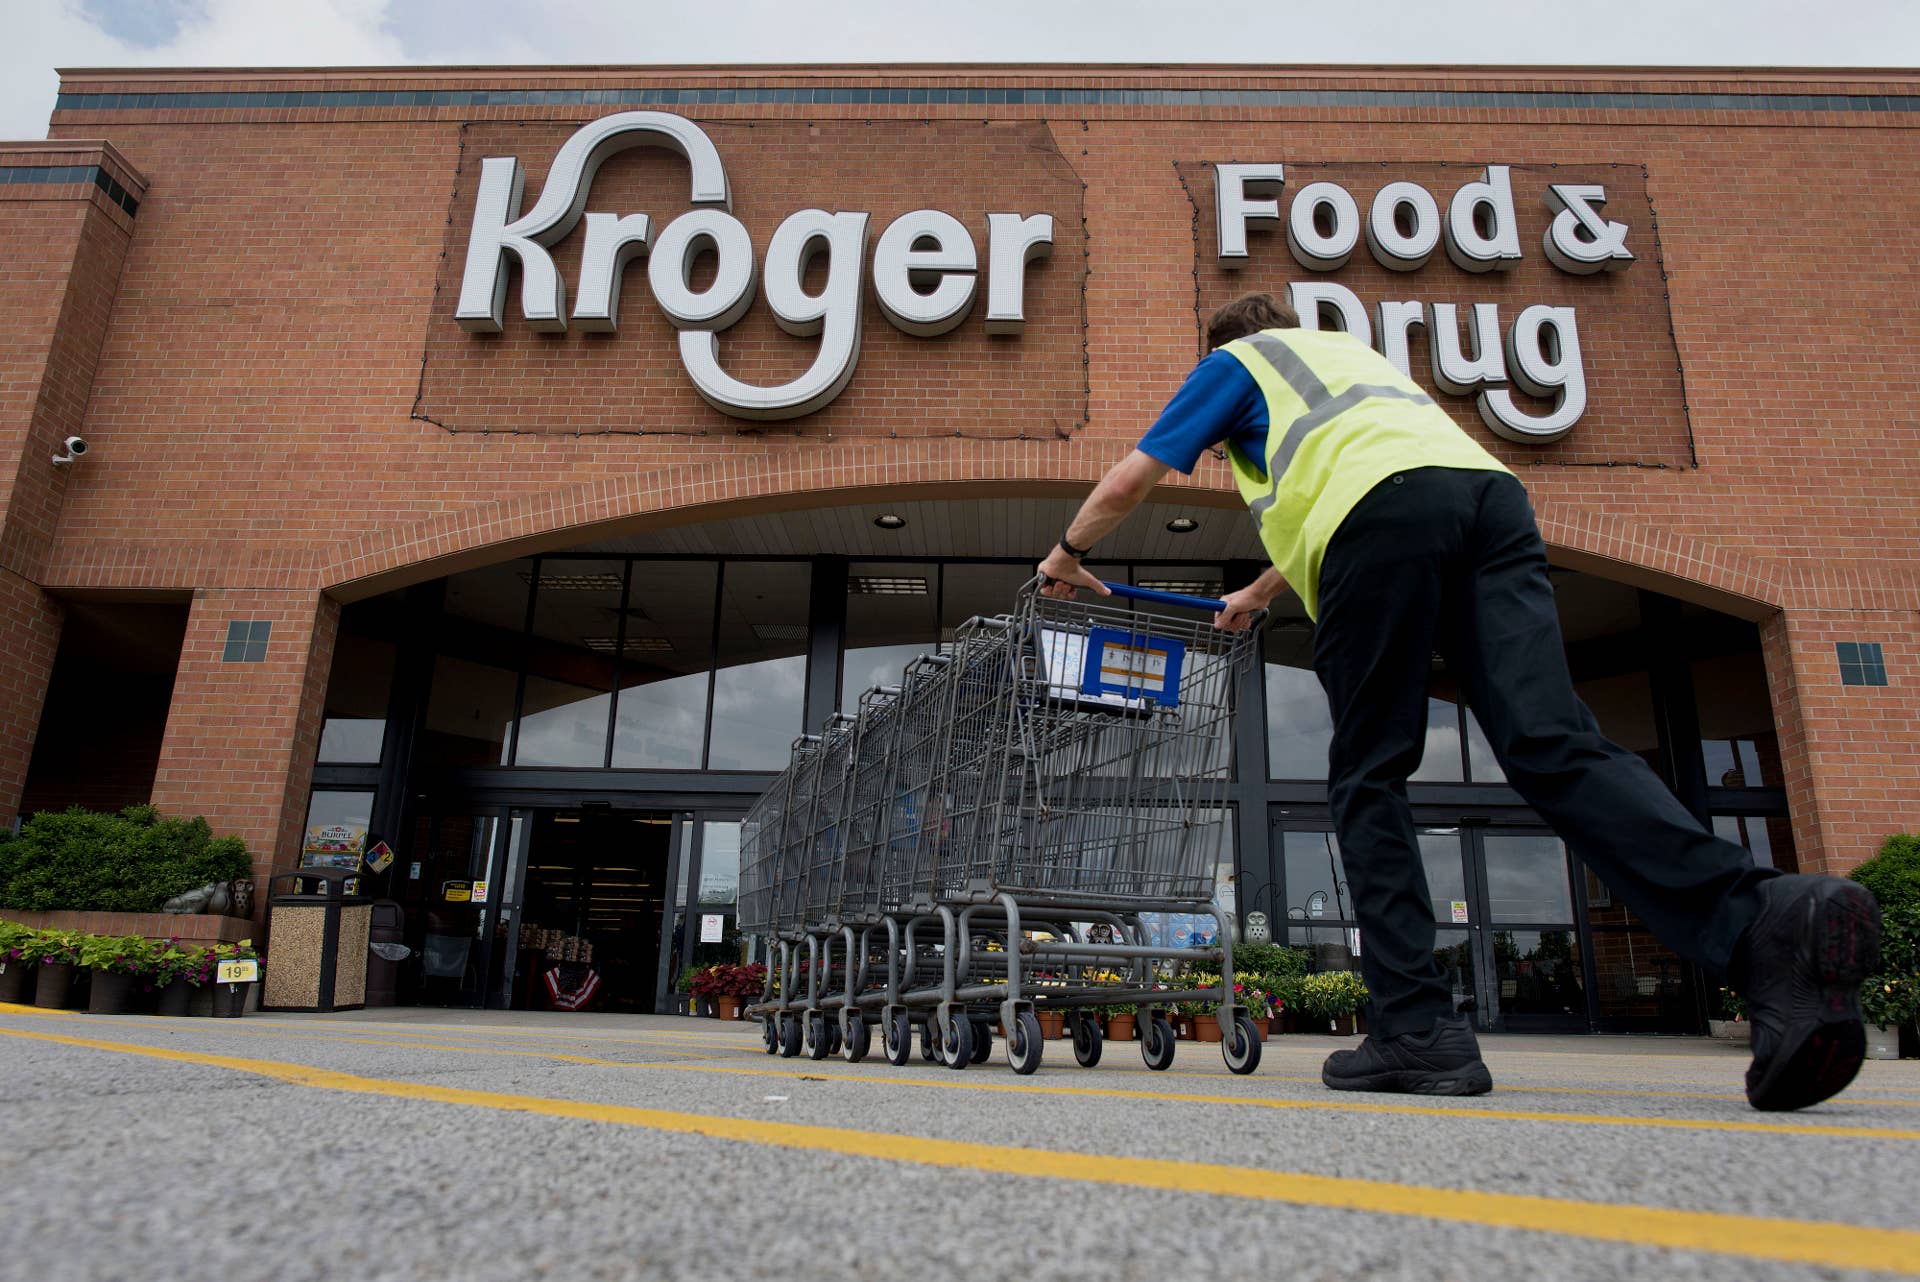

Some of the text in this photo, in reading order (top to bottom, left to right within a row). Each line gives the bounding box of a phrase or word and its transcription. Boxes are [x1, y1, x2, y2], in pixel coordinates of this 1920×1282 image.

[454, 109, 1054, 420] Kroger
[1214, 163, 1637, 275] Food &
[383, 852, 391, 862] 2
